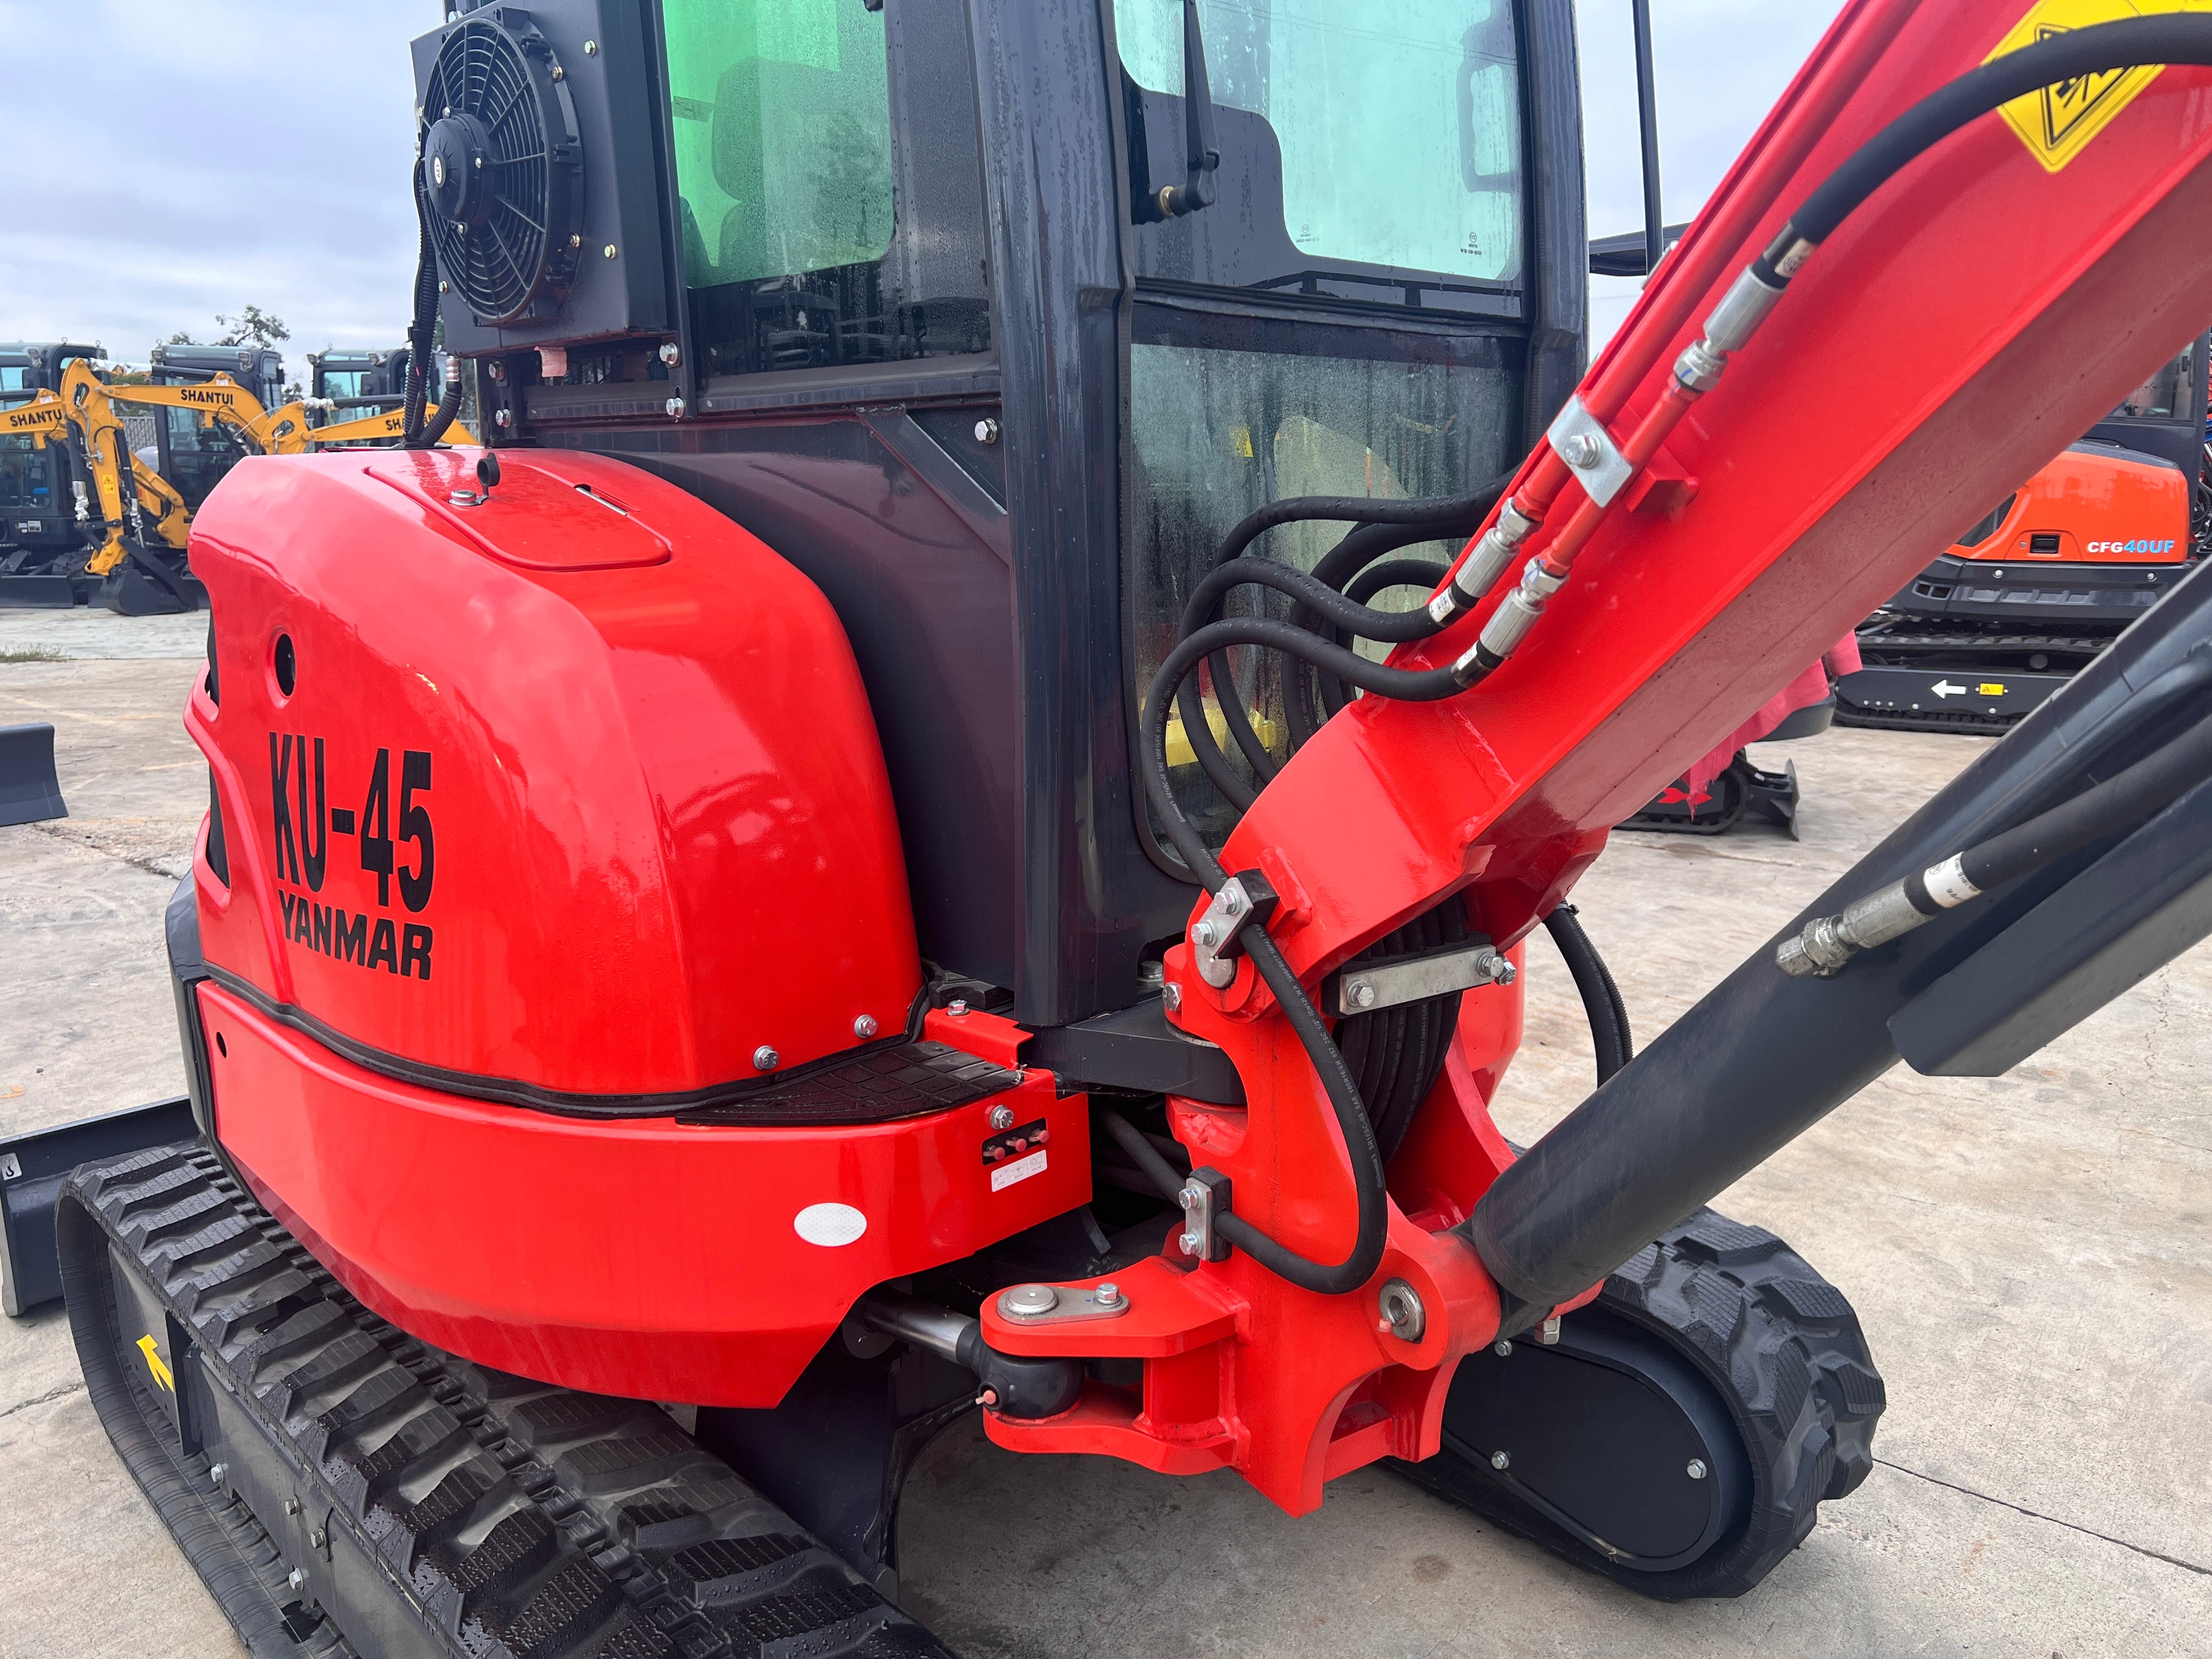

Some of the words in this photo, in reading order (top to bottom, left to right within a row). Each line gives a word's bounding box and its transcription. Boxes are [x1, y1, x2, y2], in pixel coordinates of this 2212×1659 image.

[180, 388, 233, 405] SHANTUI
[10, 408, 62, 427] SHANTU
[2088, 539, 2175, 554] CFG40UF
[269, 732, 434, 913] KU-45
[278, 889, 433, 981] YANMAR
[1312, 1019, 1322, 1030] 1/2"
[1321, 1032, 1331, 1044] 2SC
[1328, 1047, 1338, 1058] 857
[1335, 1060, 1354, 1094] 100R16/EN
[1351, 1096, 1361, 1110] SAE
[1358, 1112, 1375, 1150] SR16SC-08
